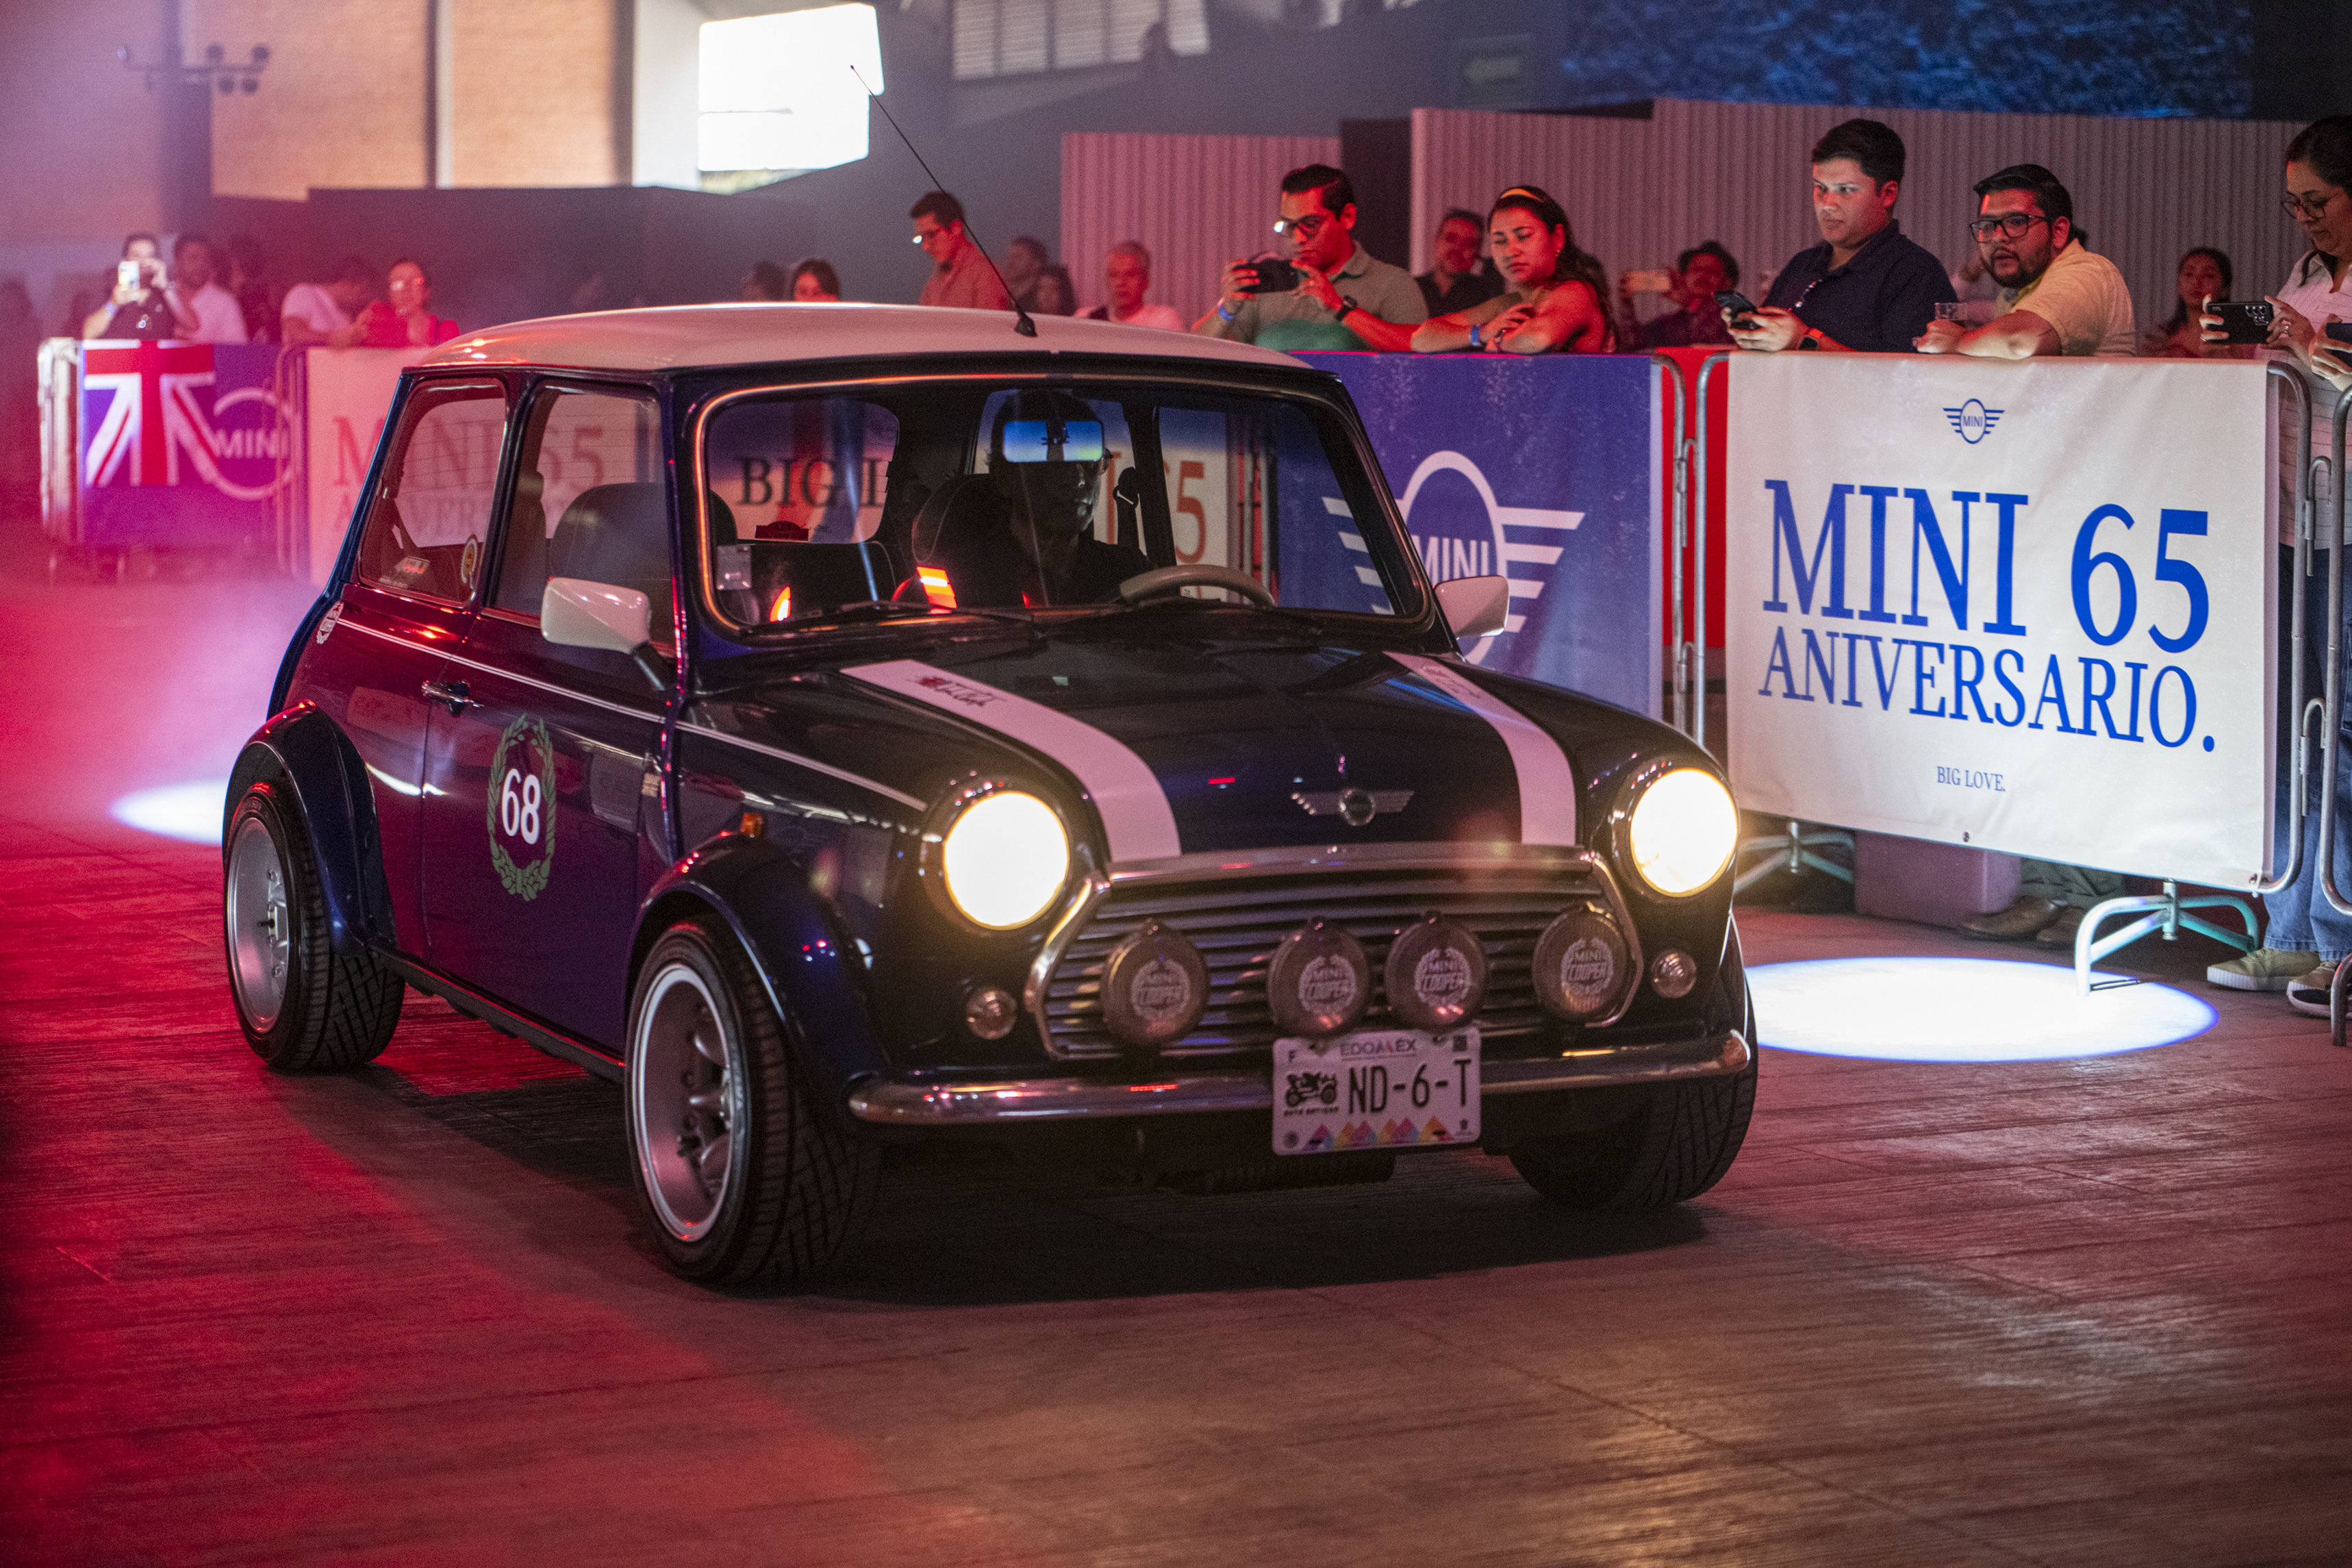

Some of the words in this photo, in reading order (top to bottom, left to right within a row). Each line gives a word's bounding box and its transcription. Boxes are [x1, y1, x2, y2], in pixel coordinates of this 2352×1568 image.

[1962, 415, 1984, 427] MINI
[735, 457, 841, 509] BIG
[1762, 479, 2028, 636] MINI
[2071, 503, 2210, 654] 65
[1758, 625, 2215, 753] ANIVERSARIO.
[501, 768, 541, 845] 68
[1936, 766, 1961, 786] BIG
[1964, 769, 2006, 792] LOVE.
[1349, 1059, 1472, 1115] ND-6-T
